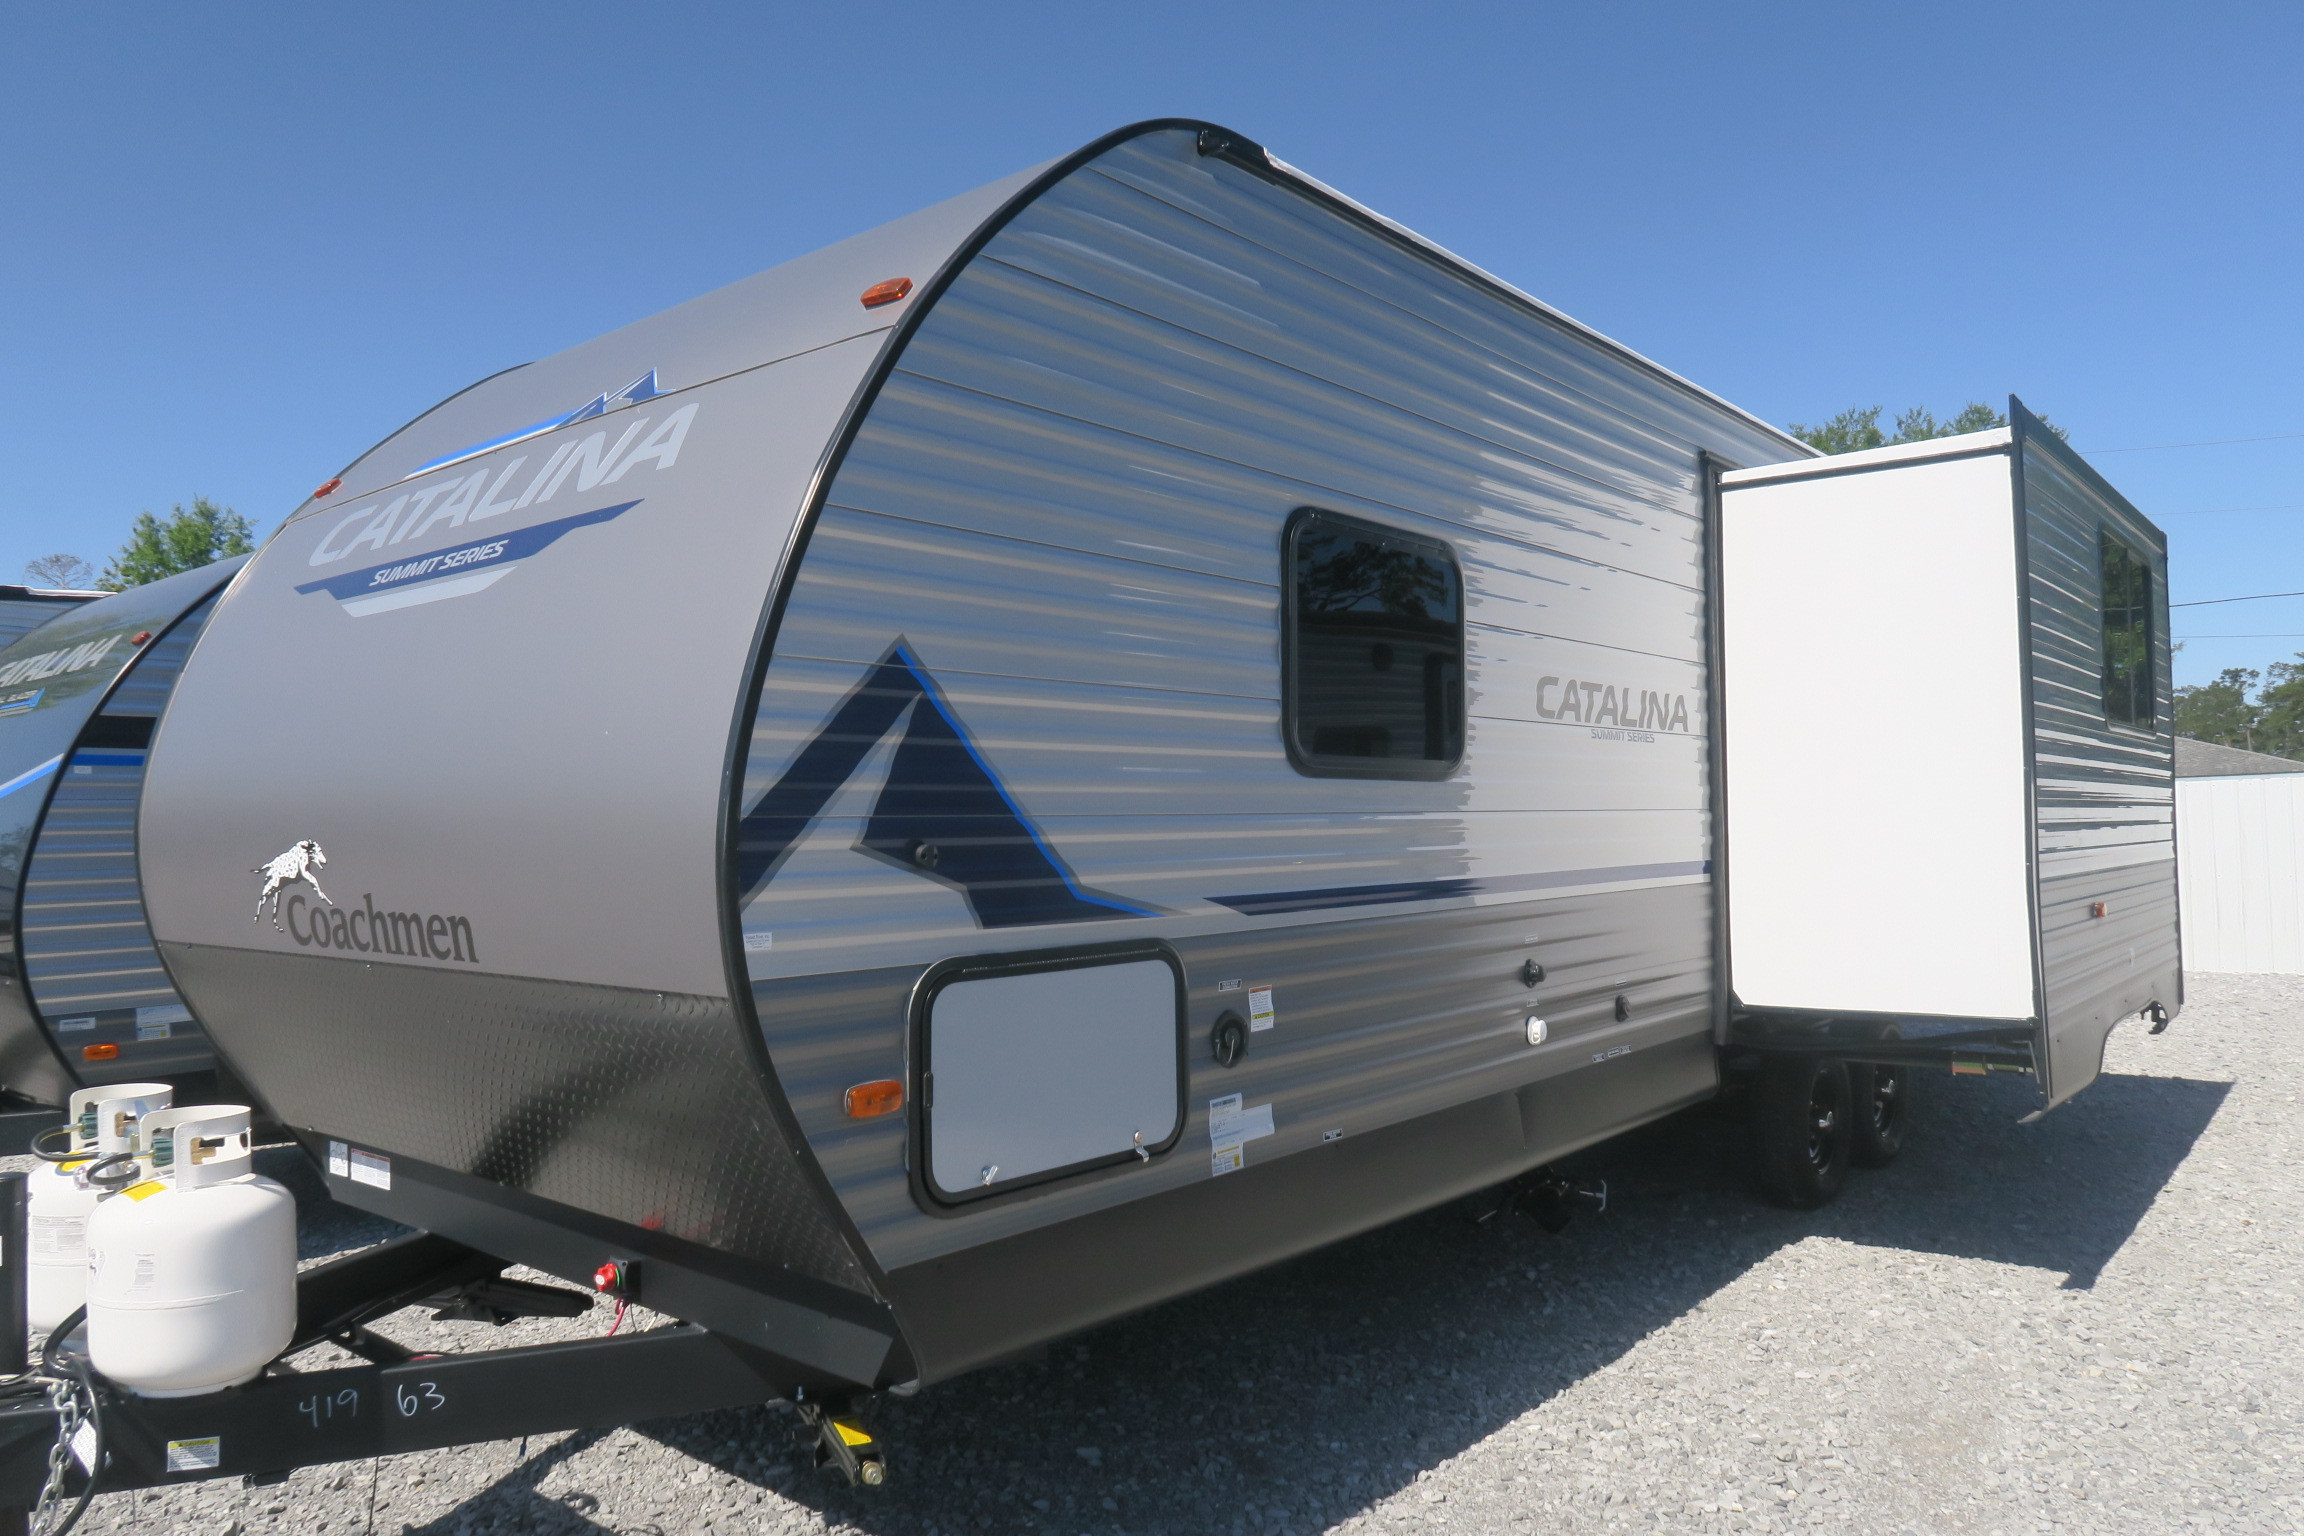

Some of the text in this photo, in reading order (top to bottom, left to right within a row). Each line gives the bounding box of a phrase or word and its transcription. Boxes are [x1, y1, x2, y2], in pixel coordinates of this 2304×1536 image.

[309, 402, 700, 567] CATALINA
[368, 539, 509, 587] SUMMIT SERIES
[1536, 675, 1689, 732] CATALINA
[1591, 728, 1655, 743] SUMMIT SERIES
[287, 892, 480, 963] Coachmen
[299, 1382, 445, 1428] 419 63
